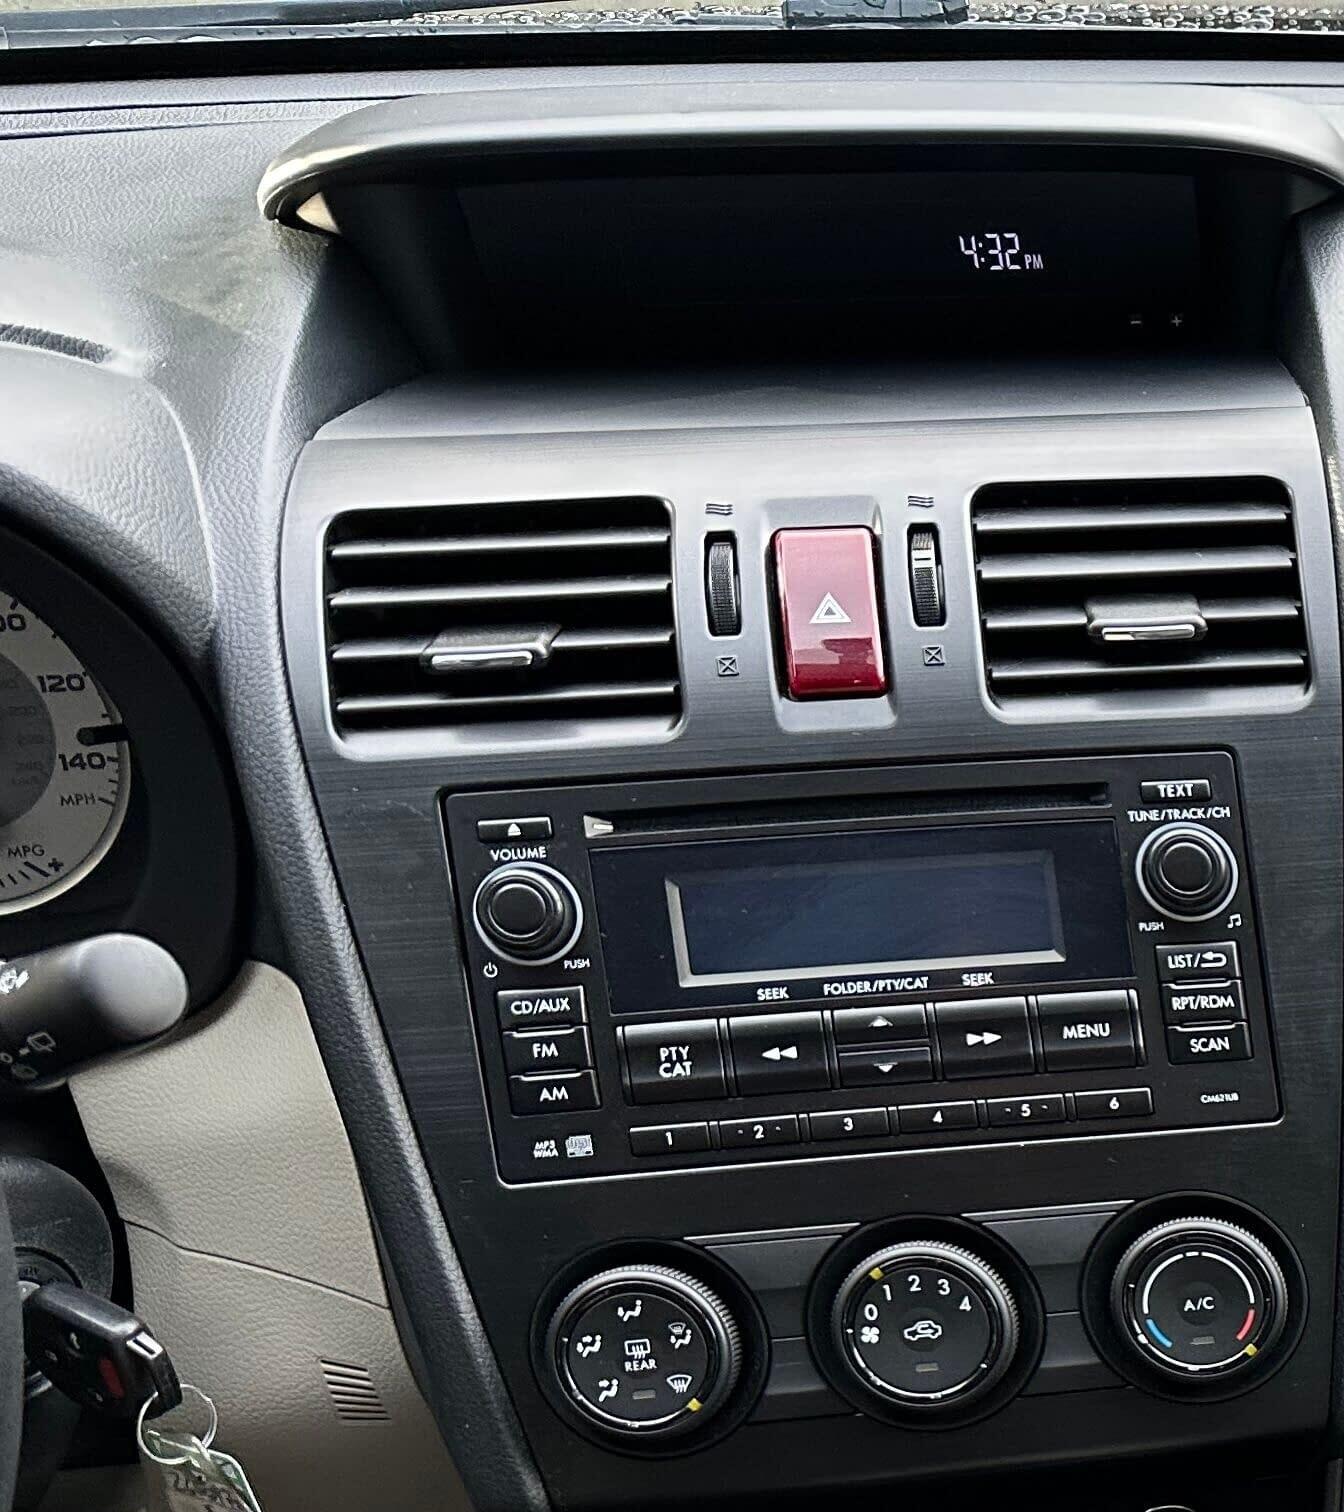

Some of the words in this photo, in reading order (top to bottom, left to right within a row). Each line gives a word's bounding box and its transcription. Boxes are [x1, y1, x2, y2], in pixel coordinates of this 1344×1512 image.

[958, 233, 1021, 270] 4:32
[1024, 254, 1044, 270] PM
[37, 673, 85, 693] 120
[58, 752, 106, 771] 140
[1157, 783, 1194, 798] TEXT
[60, 793, 97, 807] MPH
[1127, 806, 1231, 822] TUNE/TRACK/CH
[7, 845, 45, 859] MPG
[490, 846, 547, 861] VOLUME
[1138, 921, 1165, 932] PUSH
[563, 958, 591, 970] PUSH
[823, 976, 929, 996] FOLDER/PTY/CAT
[961, 972, 995, 987] SEEK
[756, 986, 790, 1001] SEEK
[510, 997, 571, 1015] CD/AUX
[1171, 994, 1235, 1011] RPT/RDM
[1062, 1022, 1111, 1040] MENU
[532, 1042, 558, 1058] FM
[1189, 1036, 1230, 1053] SCAN
[659, 1045, 689, 1062] PTY
[658, 1061, 692, 1078] CAT
[539, 1085, 569, 1102] AM
[1020, 1103, 1031, 1117] 5
[1109, 1096, 1120, 1110] 6
[843, 1117, 854, 1131] 3
[932, 1110, 943, 1124] 4
[665, 1131, 674, 1146] 1
[753, 1125, 765, 1139] 2
[535, 1139, 555, 1149] MP3
[533, 1148, 559, 1158] WMA
[907, 1275, 922, 1292] 2
[937, 1278, 951, 1295] 3
[882, 1284, 892, 1301] 1
[959, 1295, 972, 1312] 4
[1184, 1296, 1215, 1312] A/C
[864, 1303, 878, 1321] 0
[624, 1358, 657, 1372] REAR
